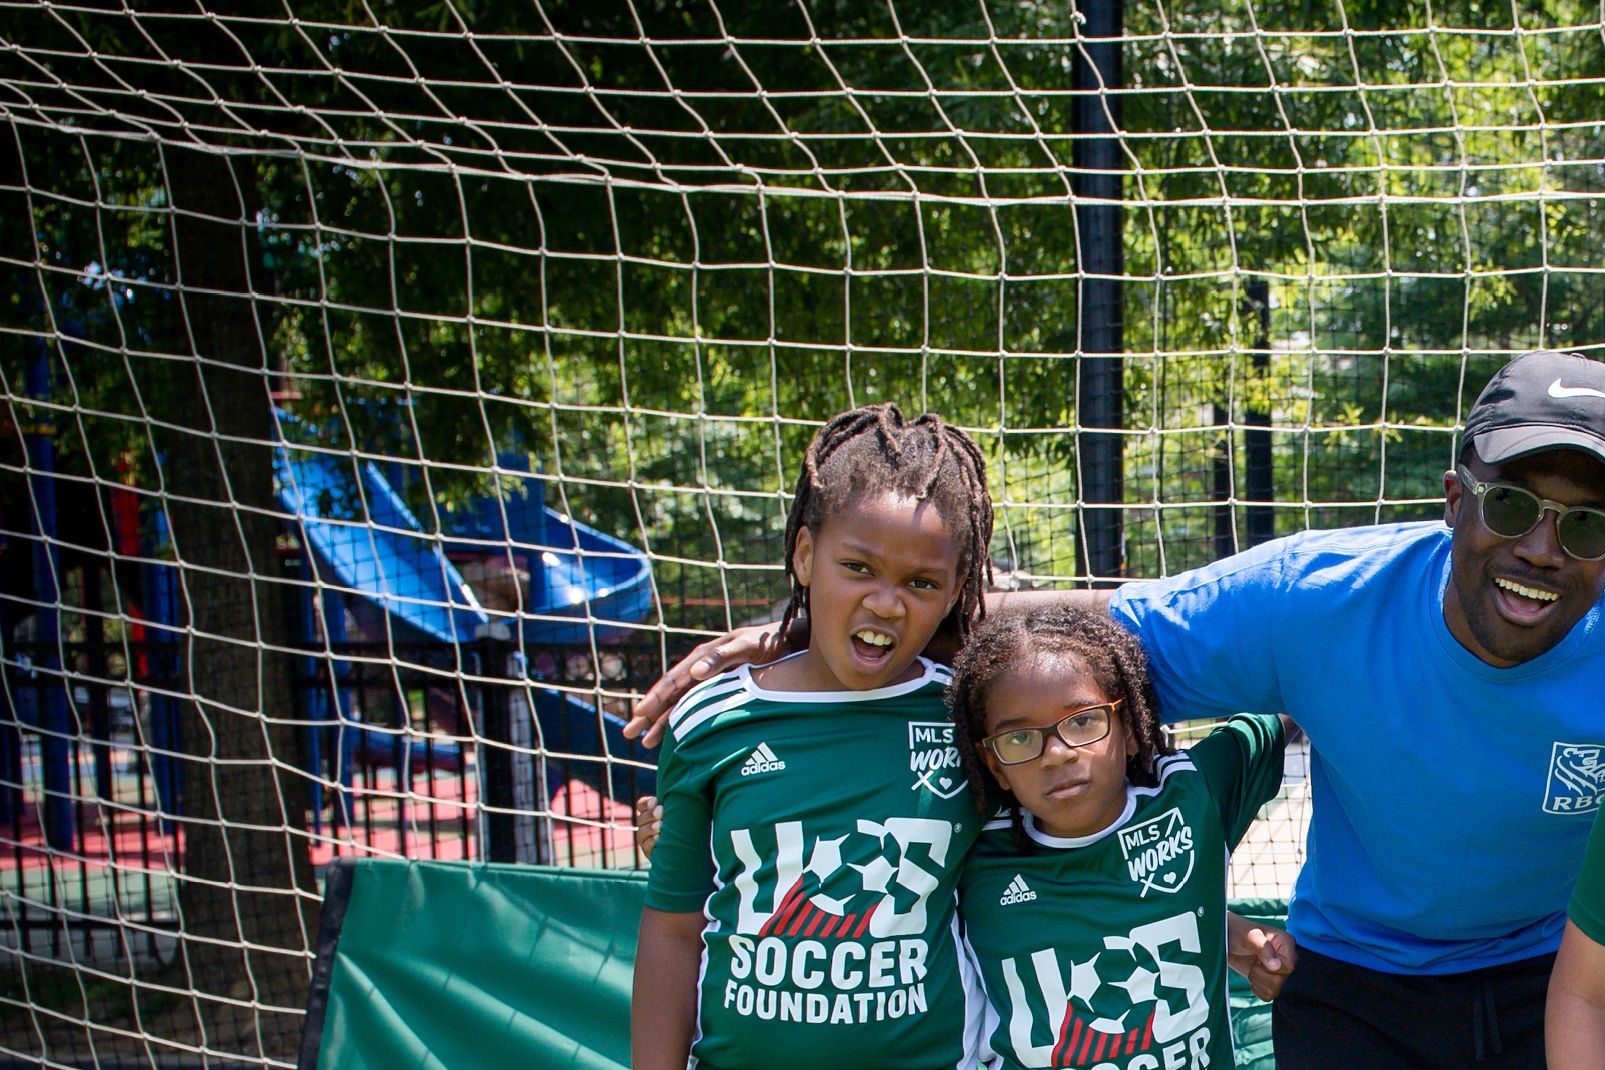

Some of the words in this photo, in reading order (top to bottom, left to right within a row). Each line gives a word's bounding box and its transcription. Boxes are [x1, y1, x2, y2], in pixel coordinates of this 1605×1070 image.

[915, 727, 954, 744] MLS
[741, 759, 786, 777] adidas
[910, 746, 962, 772] WOR
[1125, 825, 1160, 851] MLS
[1127, 825, 1194, 883] WORKS
[1000, 889, 1037, 906] adidas
[728, 934, 929, 990] SOCCER
[724, 979, 928, 1025] FOUNDATION
